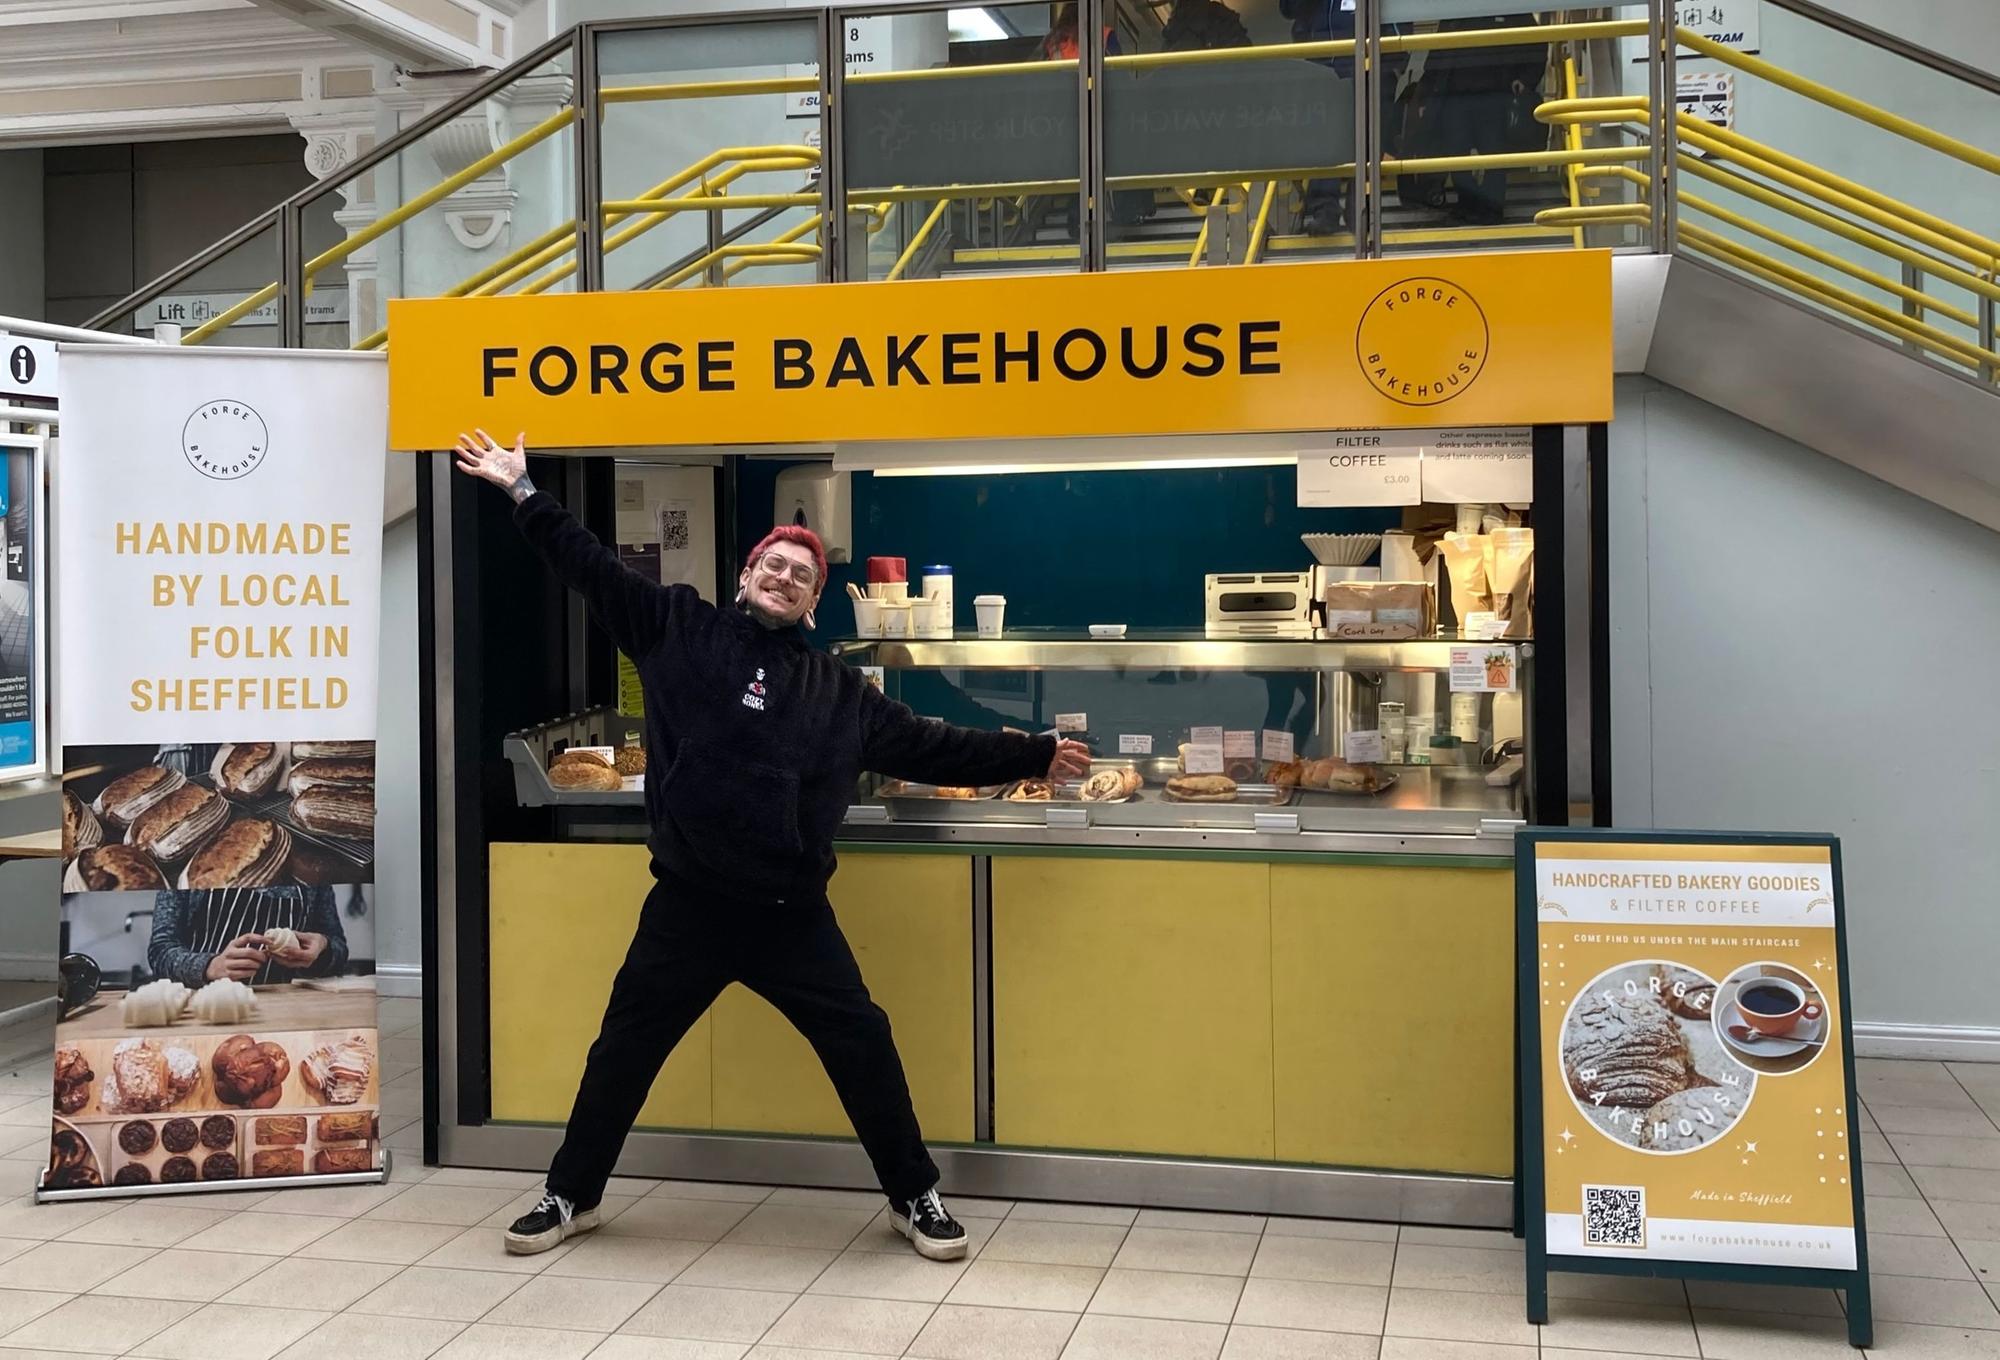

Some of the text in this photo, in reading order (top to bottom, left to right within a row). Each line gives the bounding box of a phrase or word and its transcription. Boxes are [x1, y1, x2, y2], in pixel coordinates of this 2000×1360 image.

[850, 28, 859, 42] 8
[845, 52, 874, 63] ams
[1384, 287, 1460, 312] FORGE
[158, 304, 185, 320] Lift
[310, 306, 335, 315] trams
[483, 320, 1281, 397] FORGE BAKEHOUSE
[1368, 348, 1479, 397] BAKEHOUSE
[202, 406, 250, 420] FORGE
[1336, 436, 1381, 447] FILTER
[1435, 441, 1461, 449] drinks
[1463, 440, 1482, 448] such
[1494, 440, 1509, 448] flat
[190, 445, 260, 475] BAKEHOUSE
[1329, 455, 1387, 467] COFFEE
[1474, 453, 1503, 462] coming
[1384, 475, 1410, 485] £3.00
[116, 522, 351, 555] HANDMADE
[152, 573, 350, 607] BY LOCAL
[190, 625, 349, 659] FOLK IN
[130, 677, 349, 712] SHEFFIELD
[1552, 872, 1820, 892] HANDCRAFTED BAKERY GOODIES
[1610, 899, 1760, 914] & FILTER COFFEE
[1574, 934, 1800, 947] COME FIND US UNDER THE MAIN STAIRCASE
[1602, 976, 1710, 1010] FORGE
[1580, 1068, 1740, 1139] BAKEHOUSE
[1689, 1190, 1793, 1207] Made in Sheffield
